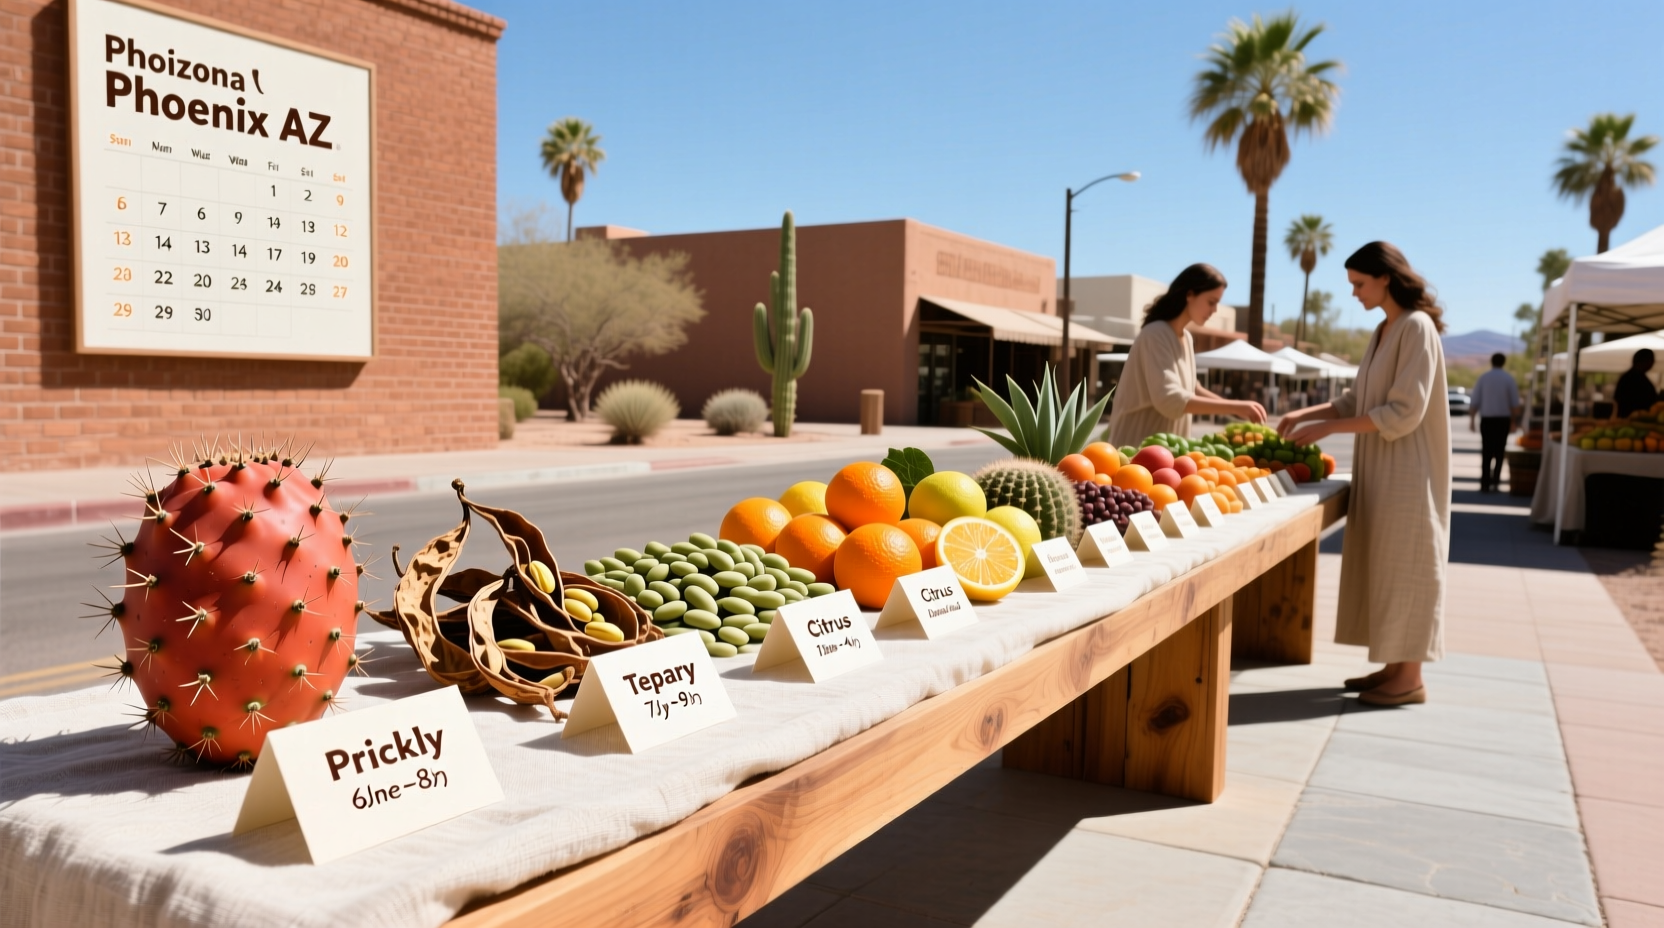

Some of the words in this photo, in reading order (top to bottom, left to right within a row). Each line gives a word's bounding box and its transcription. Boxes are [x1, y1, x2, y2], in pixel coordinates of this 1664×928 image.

[105, 34, 245, 92] Phoizona
[105, 70, 269, 138] Phoenix
[279, 108, 332, 149] AZ
[270, 184, 276, 198] 1
[303, 189, 313, 202] 2
[335, 194, 345, 207] 9
[116, 196, 128, 211] 6
[157, 201, 168, 216] 7
[197, 206, 207, 221] 6
[234, 211, 243, 225] 9
[333, 223, 348, 238] 12
[114, 231, 131, 246] 13
[155, 236, 172, 250] 14
[195, 240, 210, 254] 13
[232, 244, 247, 258] 14
[267, 248, 282, 261] 17
[301, 251, 315, 264] 19
[334, 255, 348, 268] 20
[155, 270, 173, 285] 22
[194, 274, 211, 288] 20
[333, 286, 347, 298] 27
[114, 303, 132, 317] 29
[155, 305, 173, 319] 29
[808, 616, 851, 637] Citrus
[622, 662, 694, 695] Tepary
[325, 726, 443, 781] Prickly
